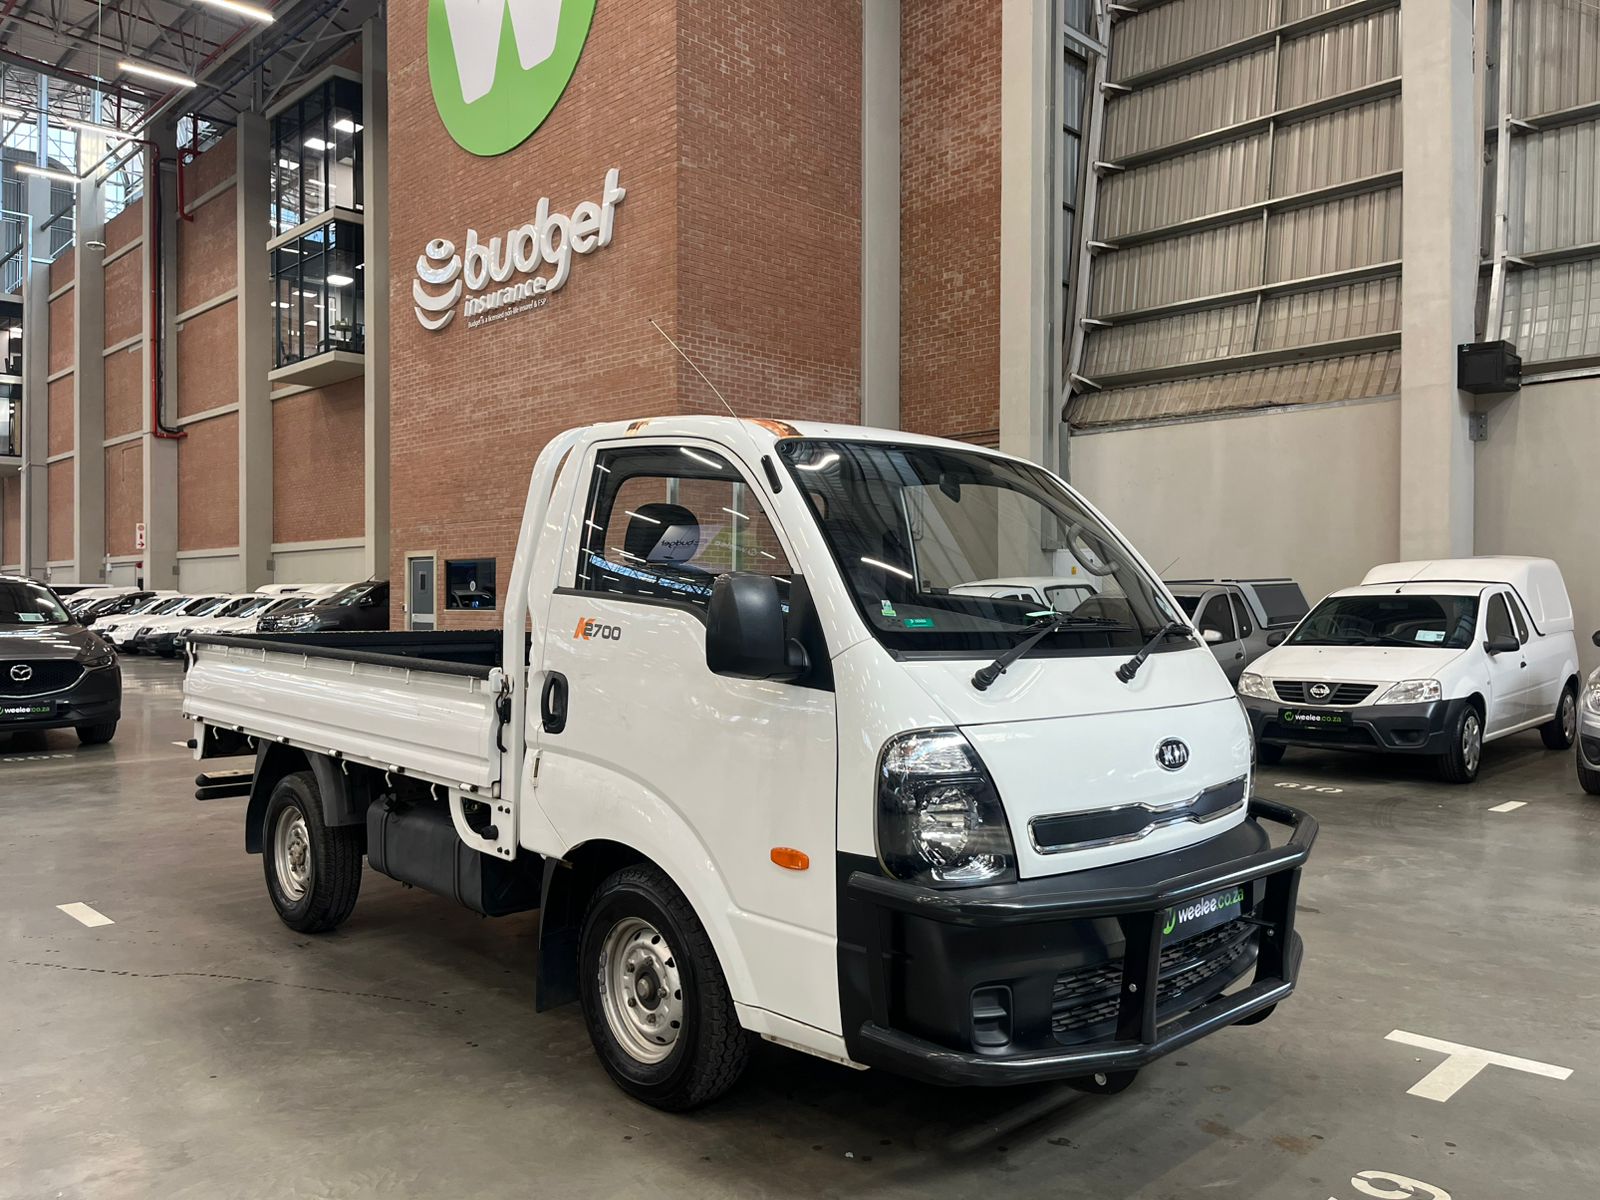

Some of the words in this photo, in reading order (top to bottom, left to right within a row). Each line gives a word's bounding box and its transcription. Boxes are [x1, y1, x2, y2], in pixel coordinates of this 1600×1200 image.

[463, 168, 627, 291] budget
[464, 277, 548, 318] insurance
[573, 617, 622, 641] K2700
[1161, 743, 1188, 766] KIA
[1178, 888, 1244, 923] weelee.co.za
